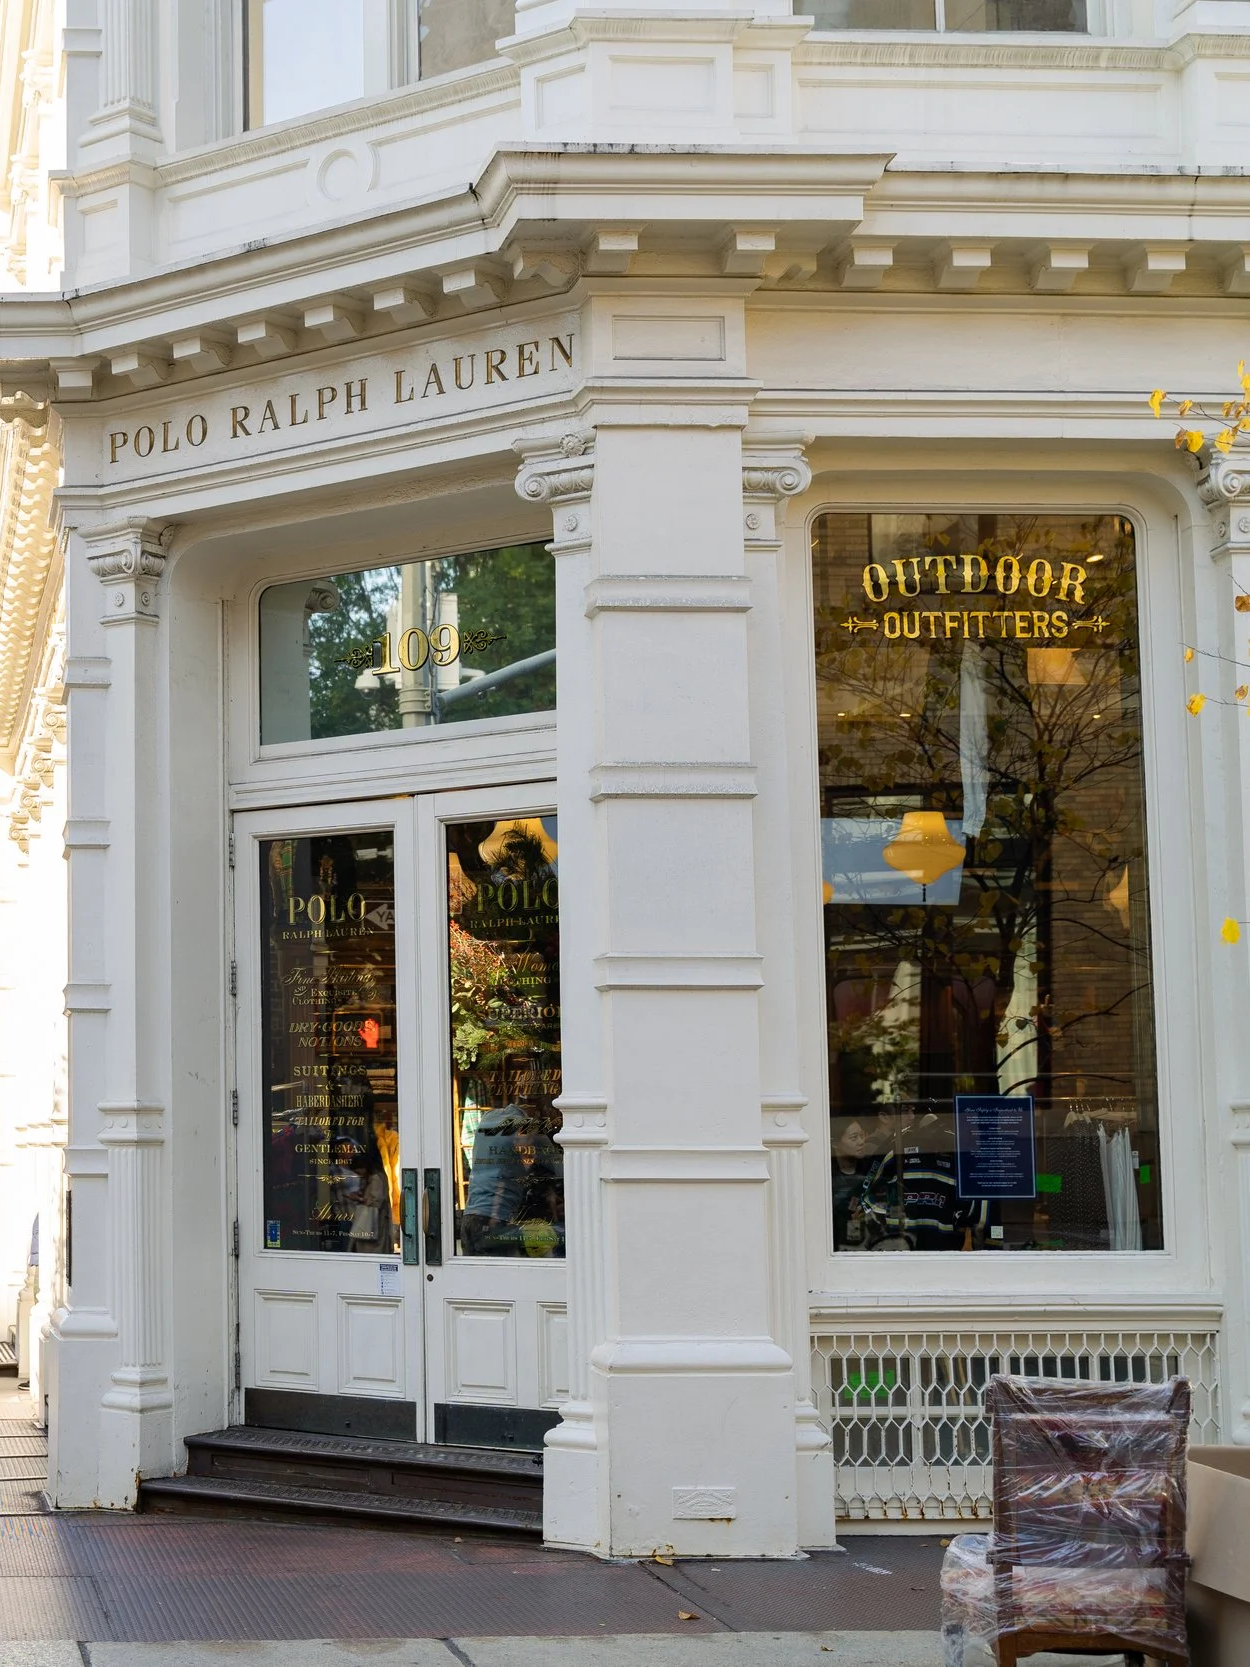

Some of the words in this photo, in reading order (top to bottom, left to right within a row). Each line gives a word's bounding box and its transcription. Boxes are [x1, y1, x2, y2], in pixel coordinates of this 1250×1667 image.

[109, 414, 208, 464] POLO
[230, 378, 368, 440] RALPH
[394, 333, 576, 404] LAUREN
[862, 554, 1088, 605] OUTDOOR
[883, 610, 1069, 639] OUTFITTERS
[372, 624, 461, 676] 109
[288, 892, 366, 925] POLO
[282, 929, 322, 940] RALPH
[326, 926, 375, 938] LAUREN
[470, 917, 515, 929] RALPH
[293, 1065, 366, 1077] SUITINGS
[296, 1095, 365, 1108] HABERDASHERY
[295, 1144, 367, 1154] GENTLEMAN
